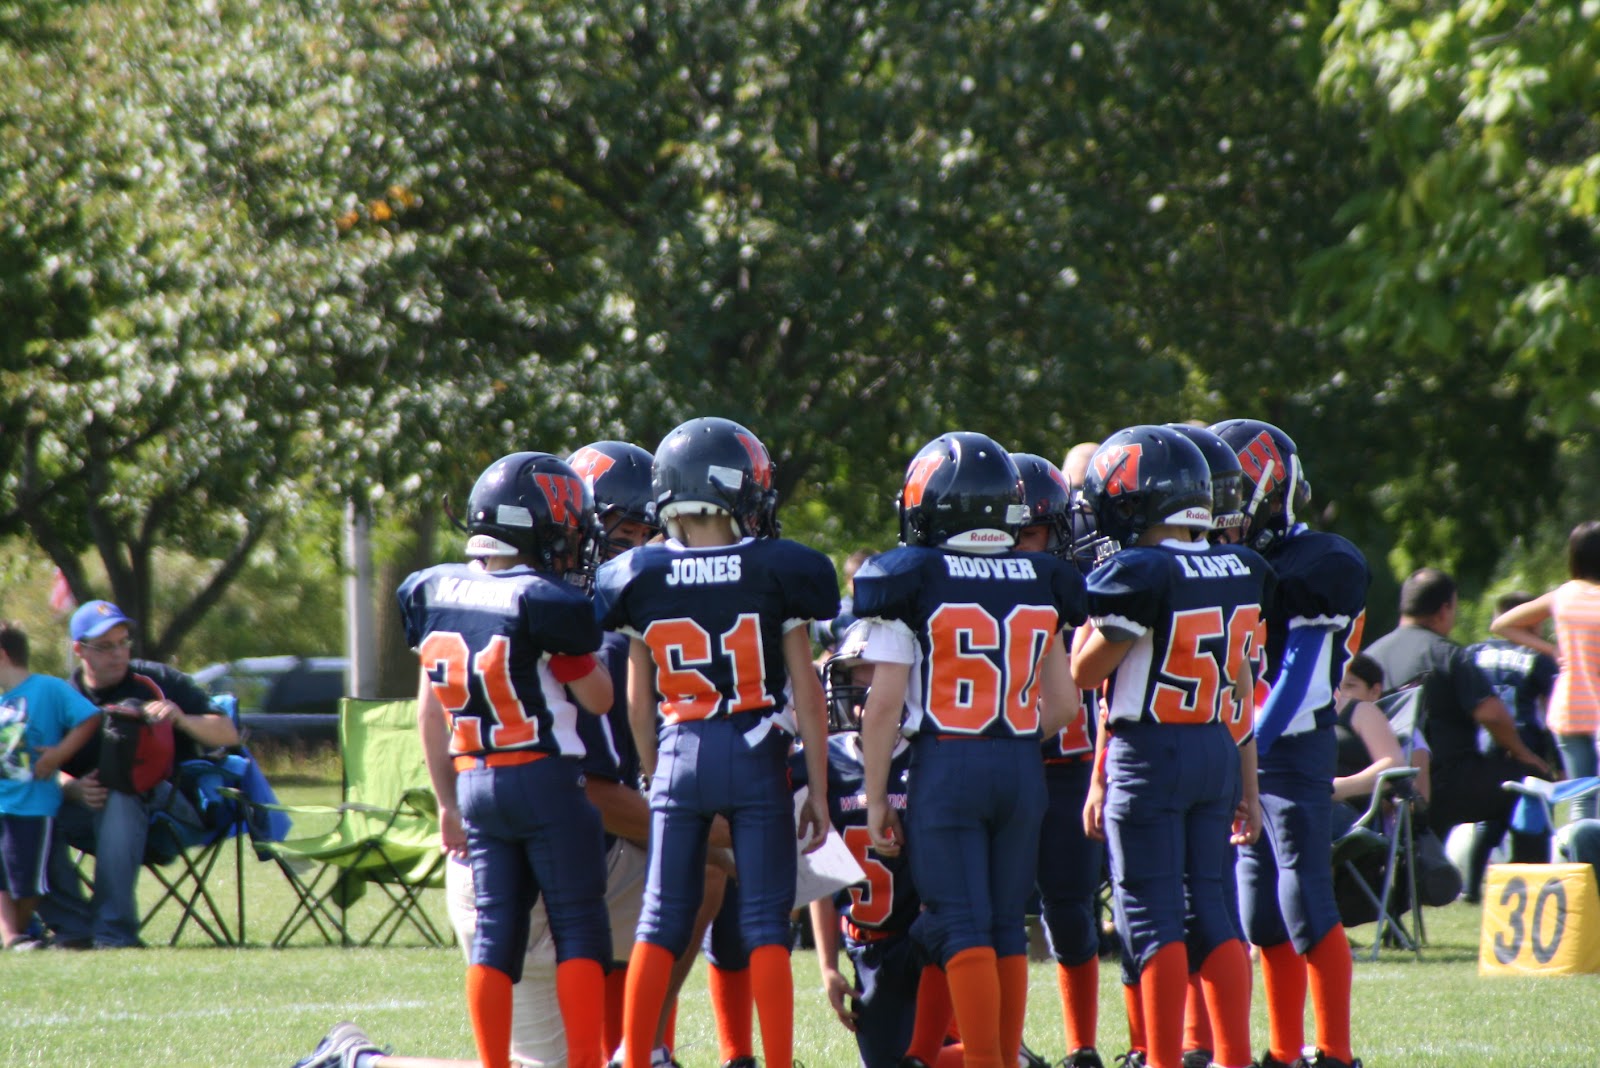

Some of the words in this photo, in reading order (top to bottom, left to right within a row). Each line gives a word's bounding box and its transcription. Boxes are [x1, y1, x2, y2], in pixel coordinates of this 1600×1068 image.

[666, 555, 742, 585] JONES
[943, 554, 1037, 580] HOOVER
[419, 631, 540, 755] 21
[643, 613, 775, 726] 61
[927, 602, 1059, 735] 60
[1493, 876, 1567, 965] 30
